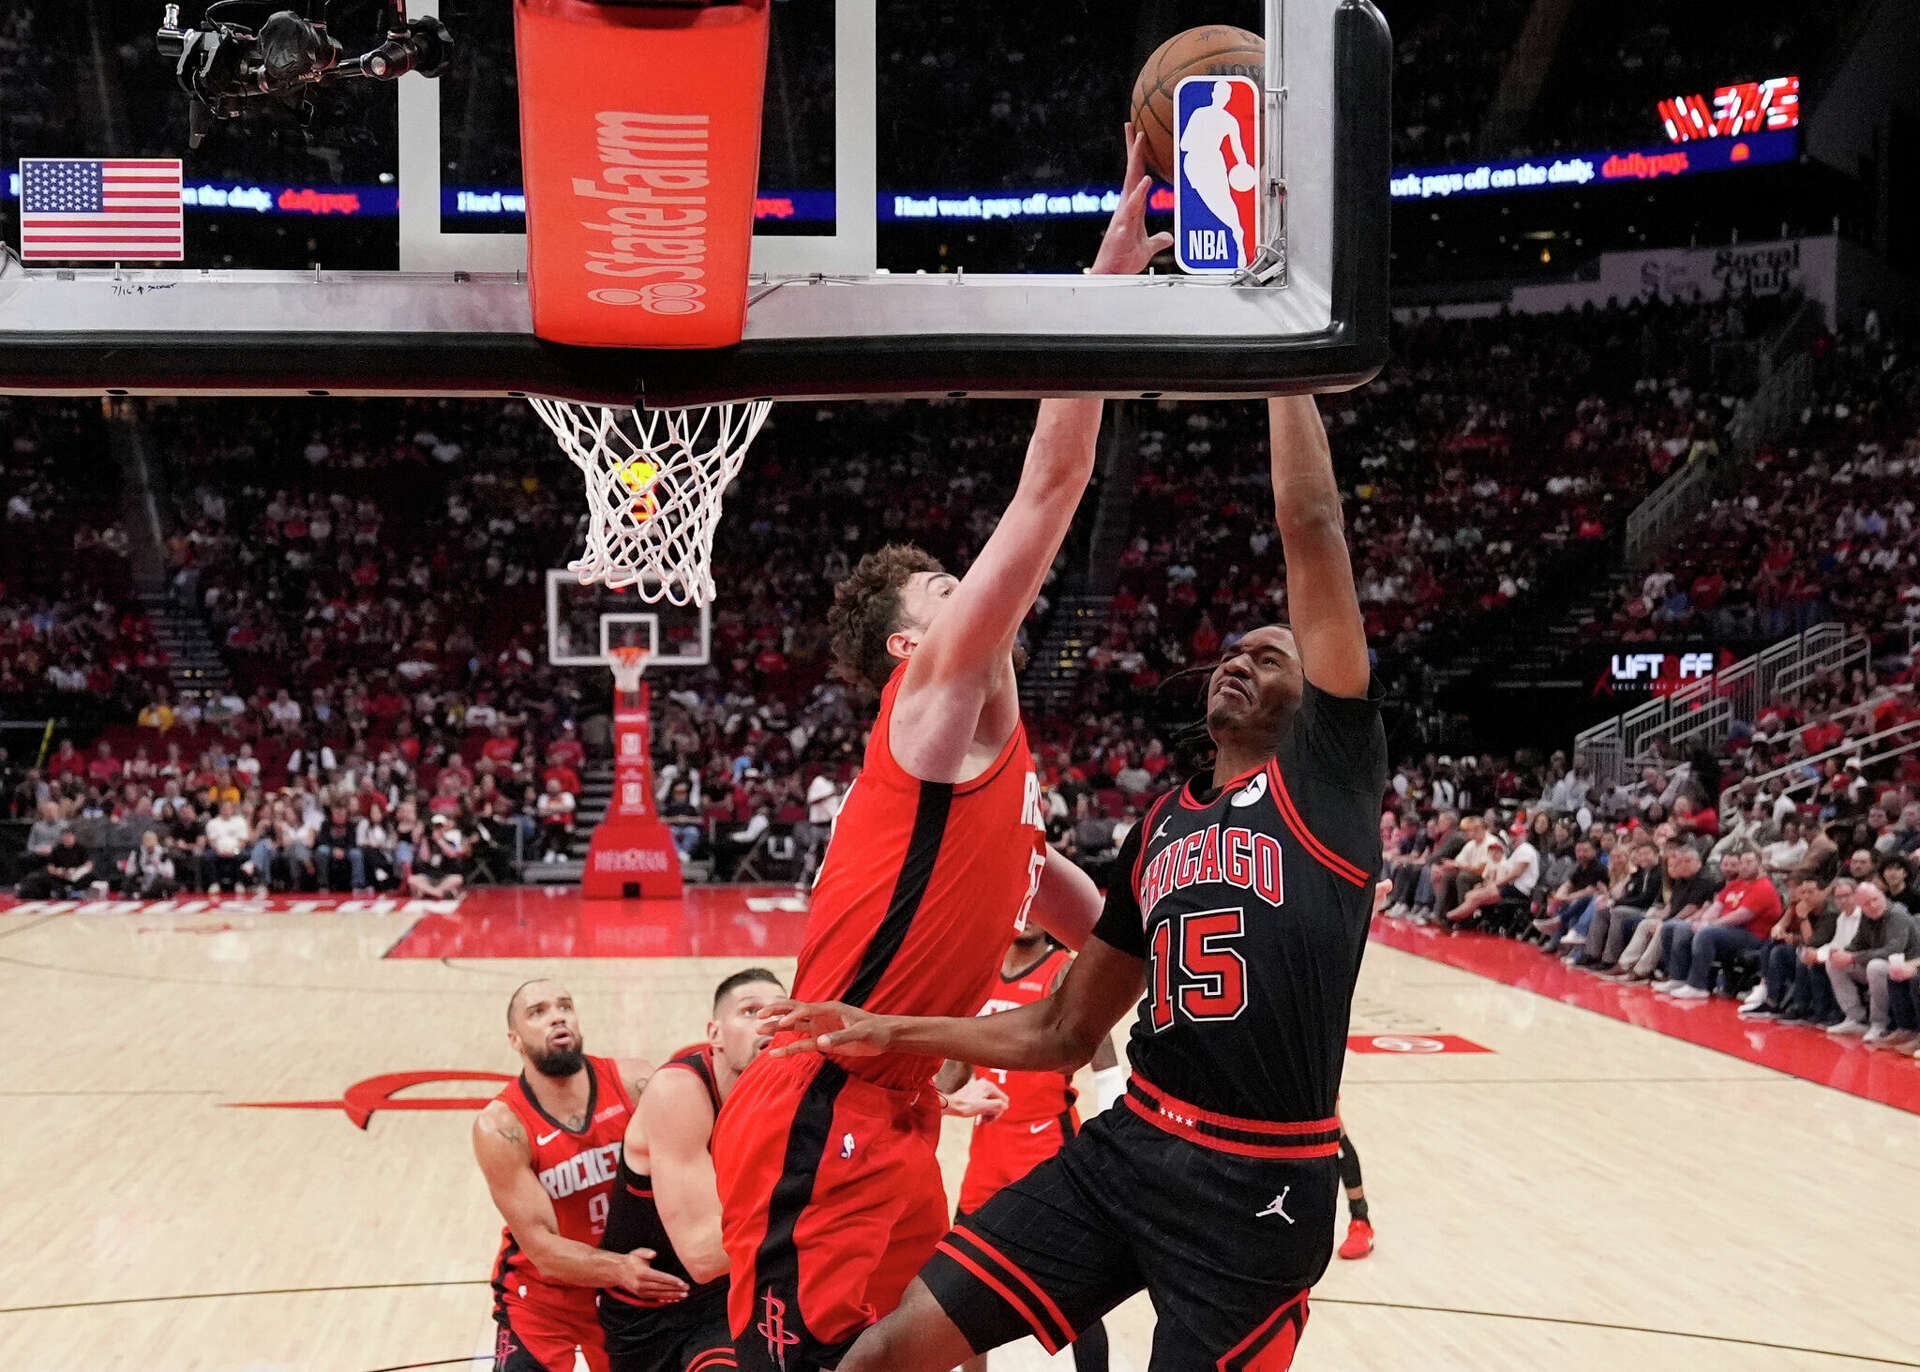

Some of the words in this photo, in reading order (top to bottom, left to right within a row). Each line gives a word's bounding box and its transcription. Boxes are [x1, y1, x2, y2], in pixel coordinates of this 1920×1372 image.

[1390, 173, 1422, 197] ork
[1516, 162, 1548, 187] the
[1188, 229, 1229, 261] NBA
[1139, 823, 1284, 934] CHICAGO
[1151, 906, 1248, 1034] 15
[538, 1141, 622, 1200] ROCKET
[588, 1192, 611, 1236] 9
